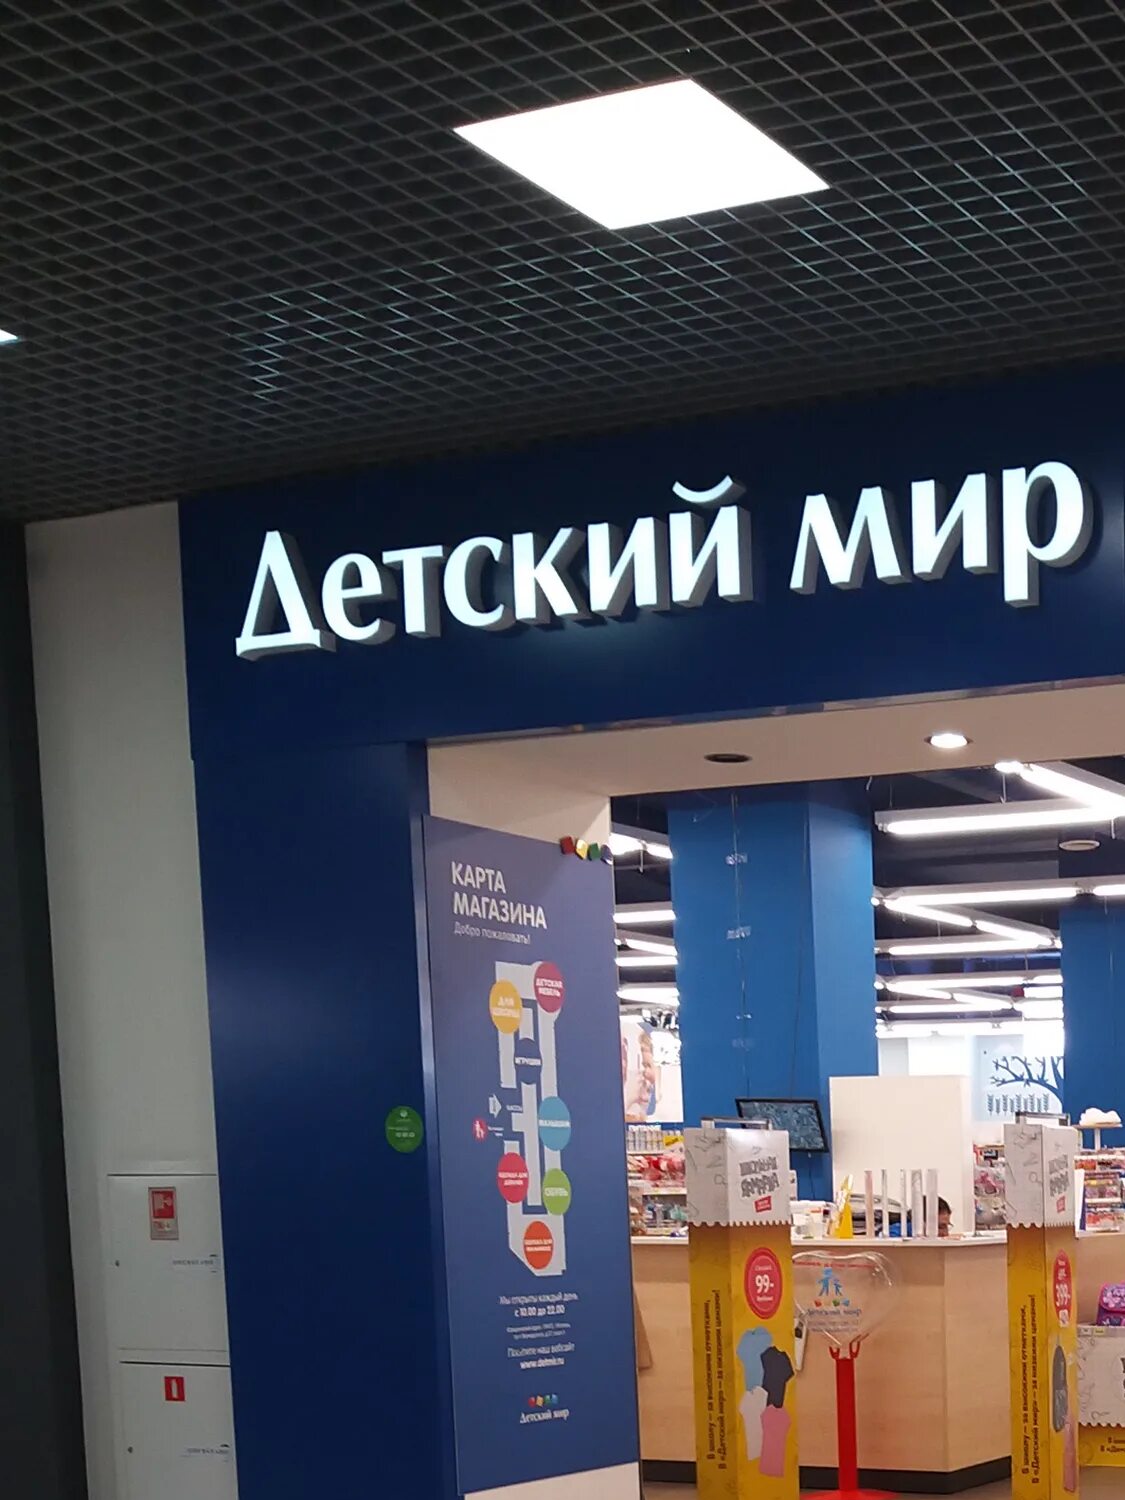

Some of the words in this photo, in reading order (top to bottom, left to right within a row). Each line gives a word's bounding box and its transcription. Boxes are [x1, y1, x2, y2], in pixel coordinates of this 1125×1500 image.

[236, 475, 747, 658] Детский
[789, 461, 1087, 606] мир
[451, 861, 506, 894] КАРТА
[453, 891, 548, 929] МАГАЗИНА
[454, 921, 481, 937] Добро
